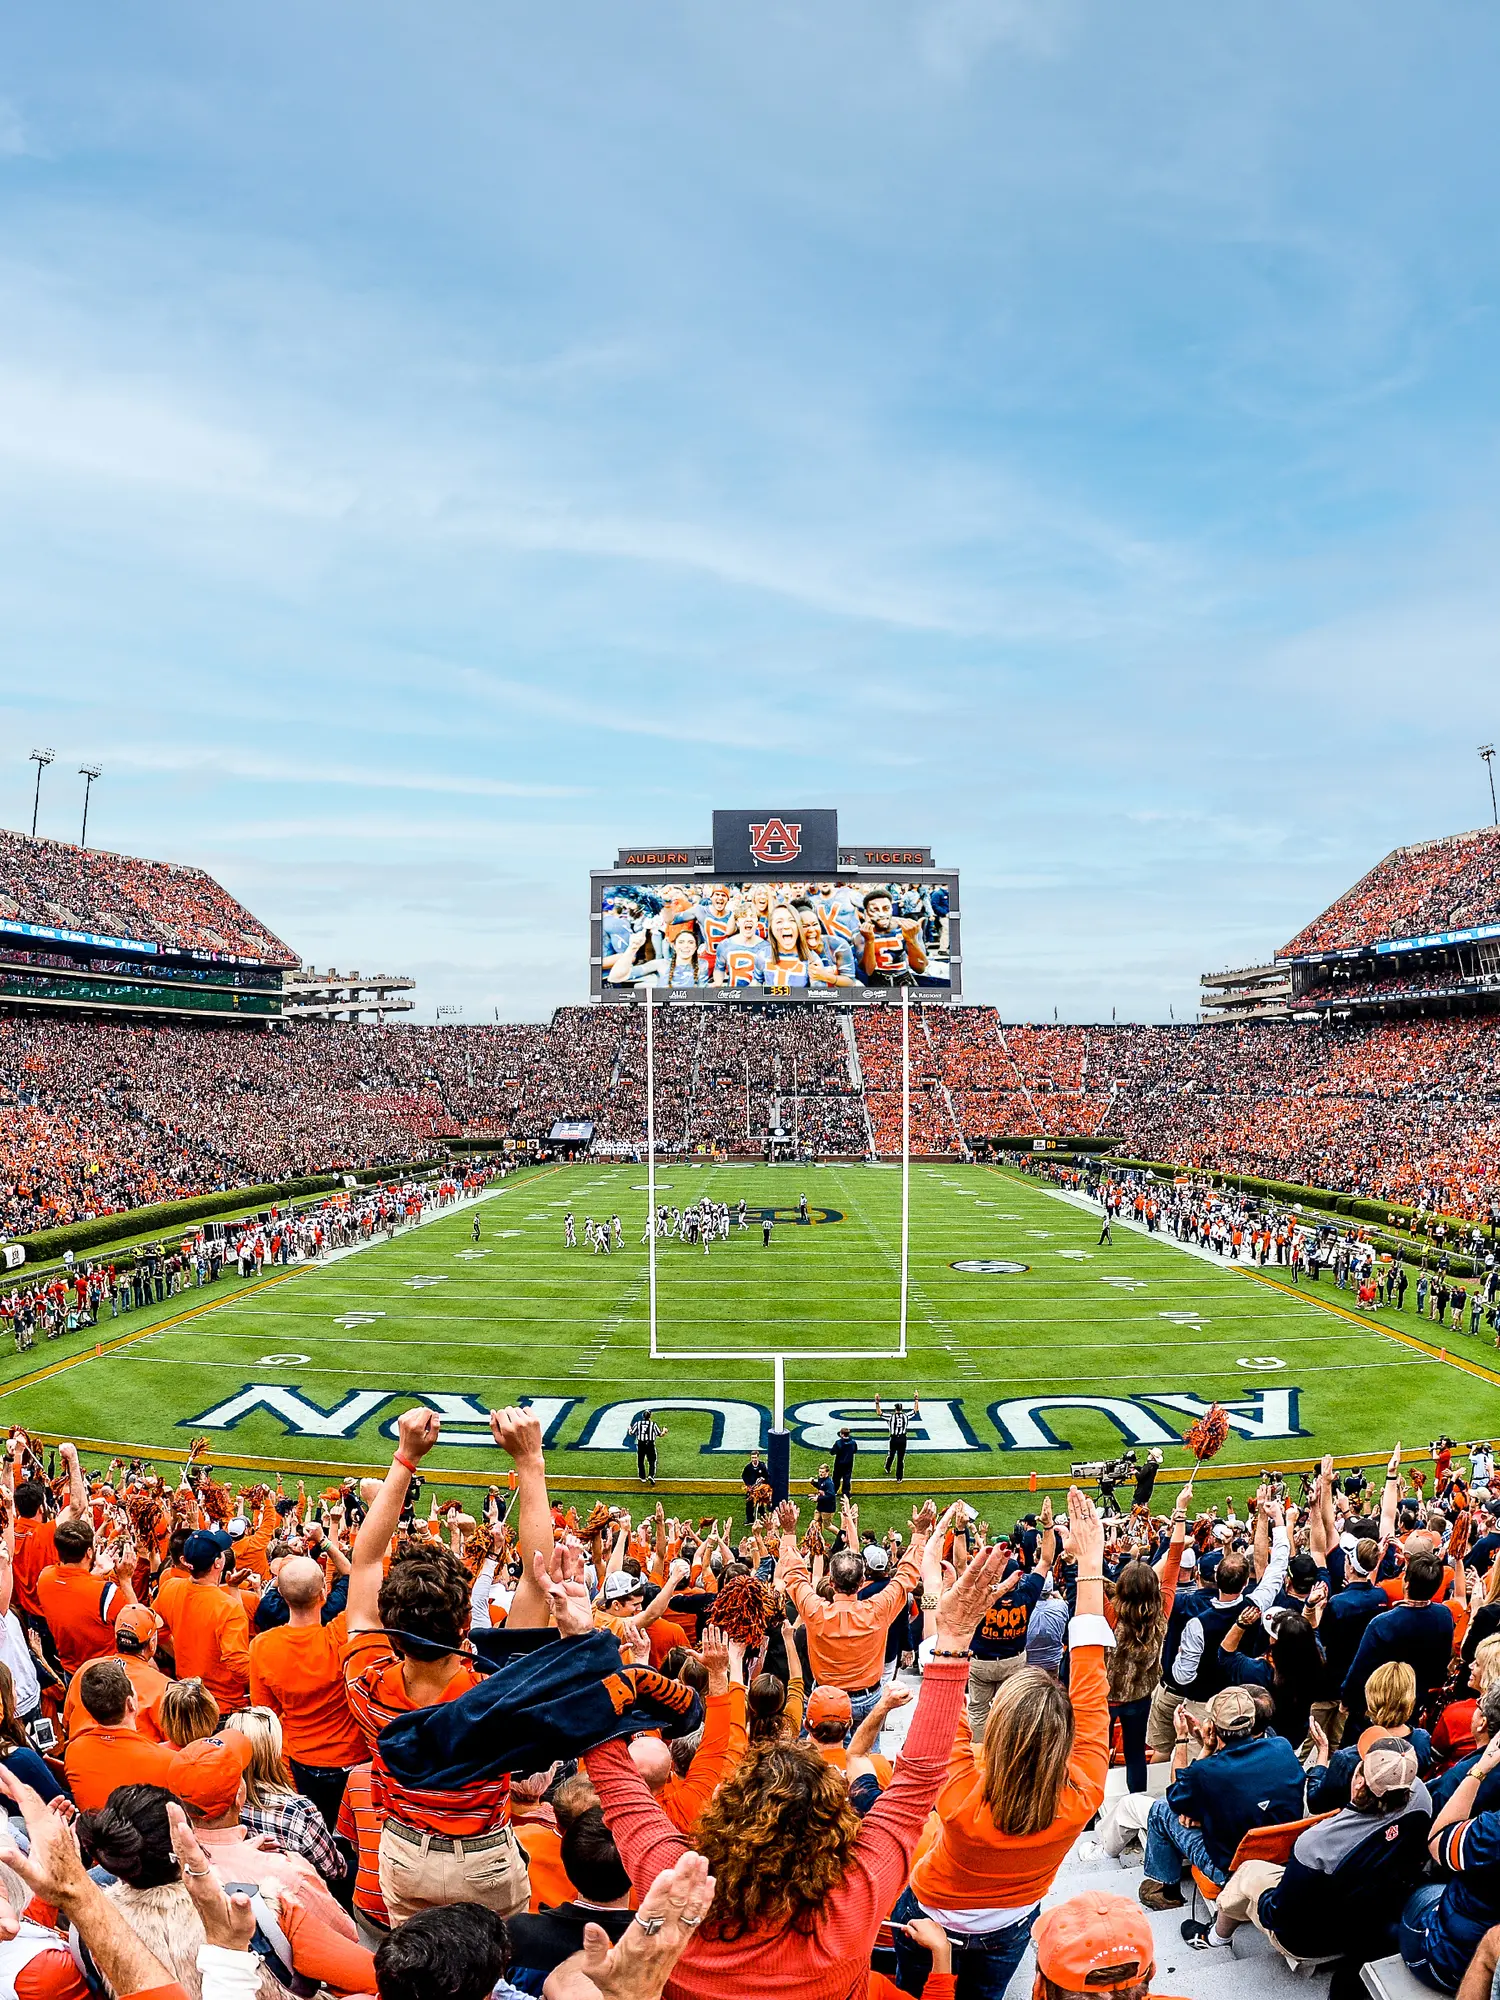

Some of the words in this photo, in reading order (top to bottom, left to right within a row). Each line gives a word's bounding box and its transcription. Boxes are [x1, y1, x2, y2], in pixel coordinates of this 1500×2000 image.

[749, 817, 802, 863] AU
[626, 853, 689, 865] AUBURN
[864, 852, 924, 864] TIGERS
[816, 901, 852, 938] K
[873, 936, 906, 971] E
[726, 950, 758, 987] R
[254, 1353, 312, 1366] G
[1236, 1356, 1287, 1370] G
[173, 1382, 1313, 1454] AUBURN
[641, 1424, 649, 1434] F
